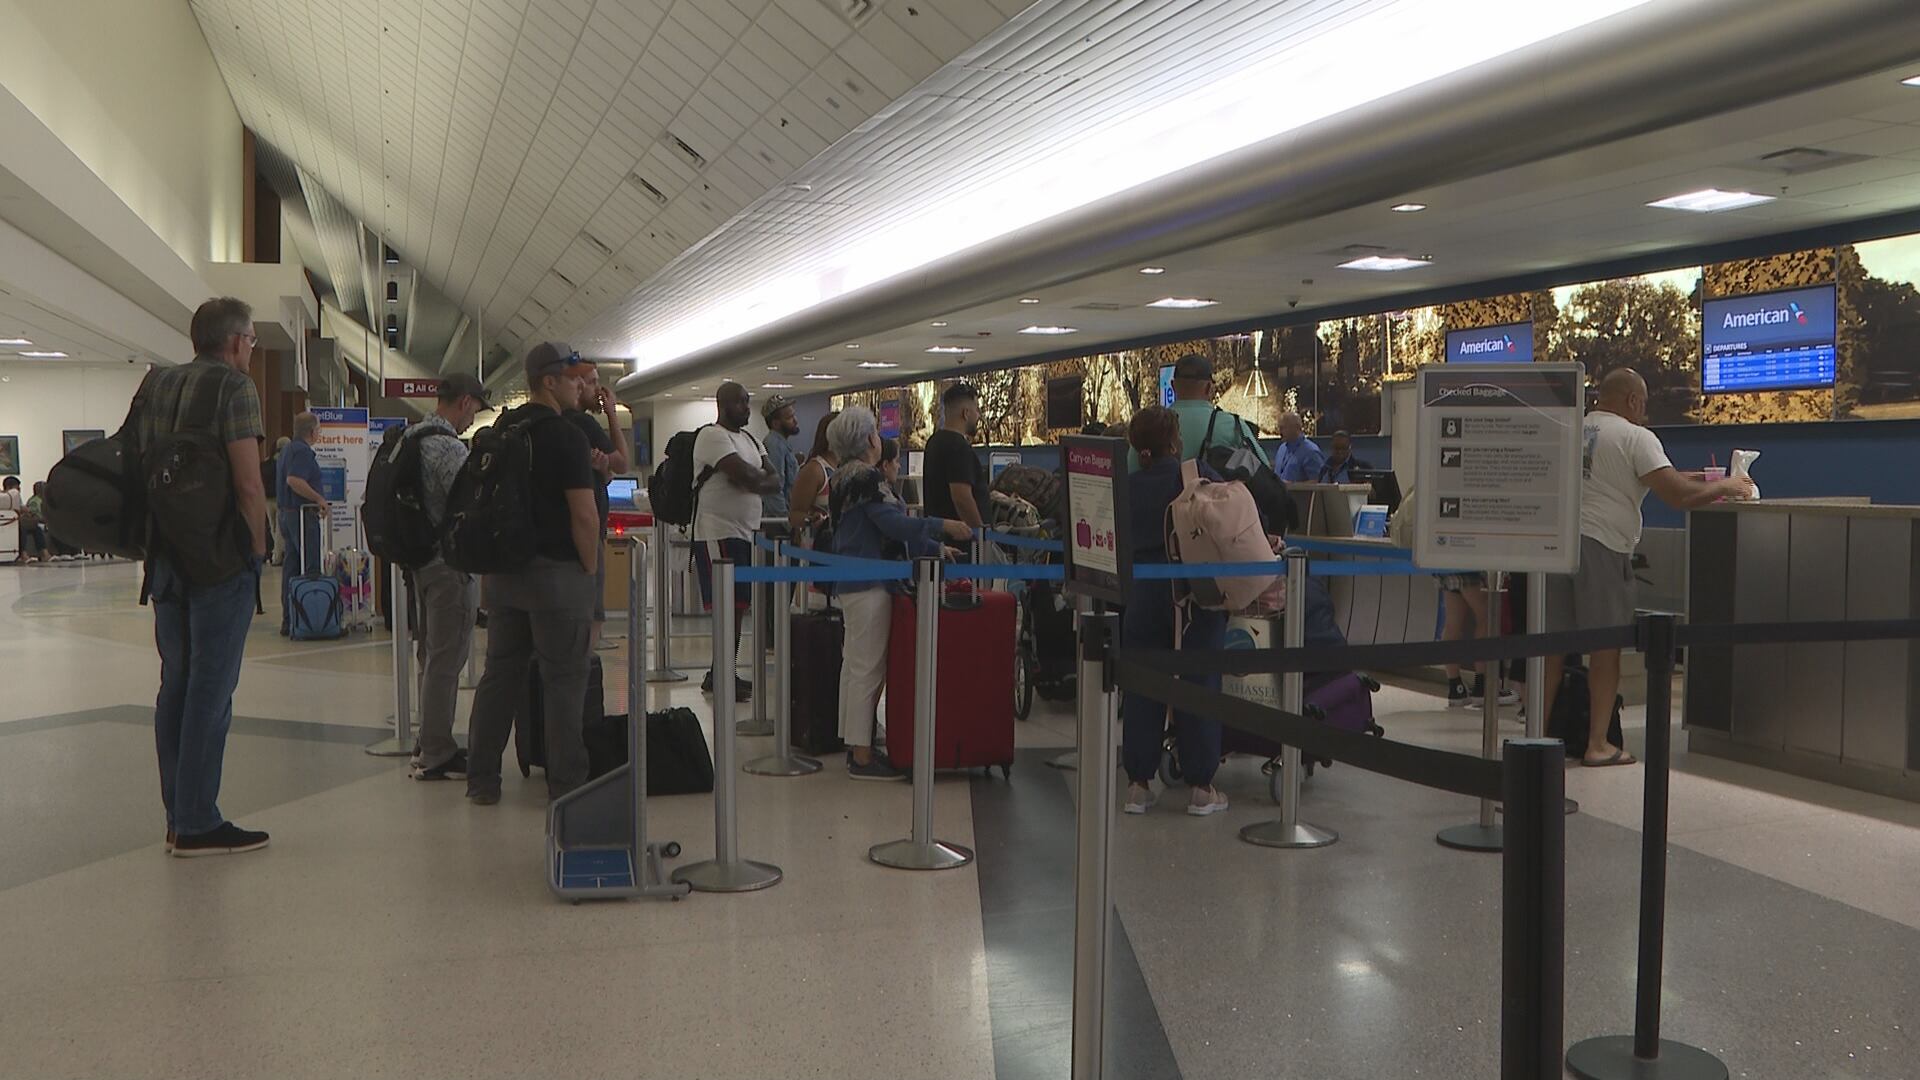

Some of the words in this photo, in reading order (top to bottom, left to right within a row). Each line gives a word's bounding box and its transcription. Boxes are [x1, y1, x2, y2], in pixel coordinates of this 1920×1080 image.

[1723, 309, 1789, 328] American
[1460, 339, 1503, 353] American
[1713, 343, 1747, 352] DEPARTURES
[415, 385, 426, 393] All
[1438, 387, 1472, 397] Checked
[343, 433, 364, 445] here
[1069, 451, 1091, 464] Carry-on
